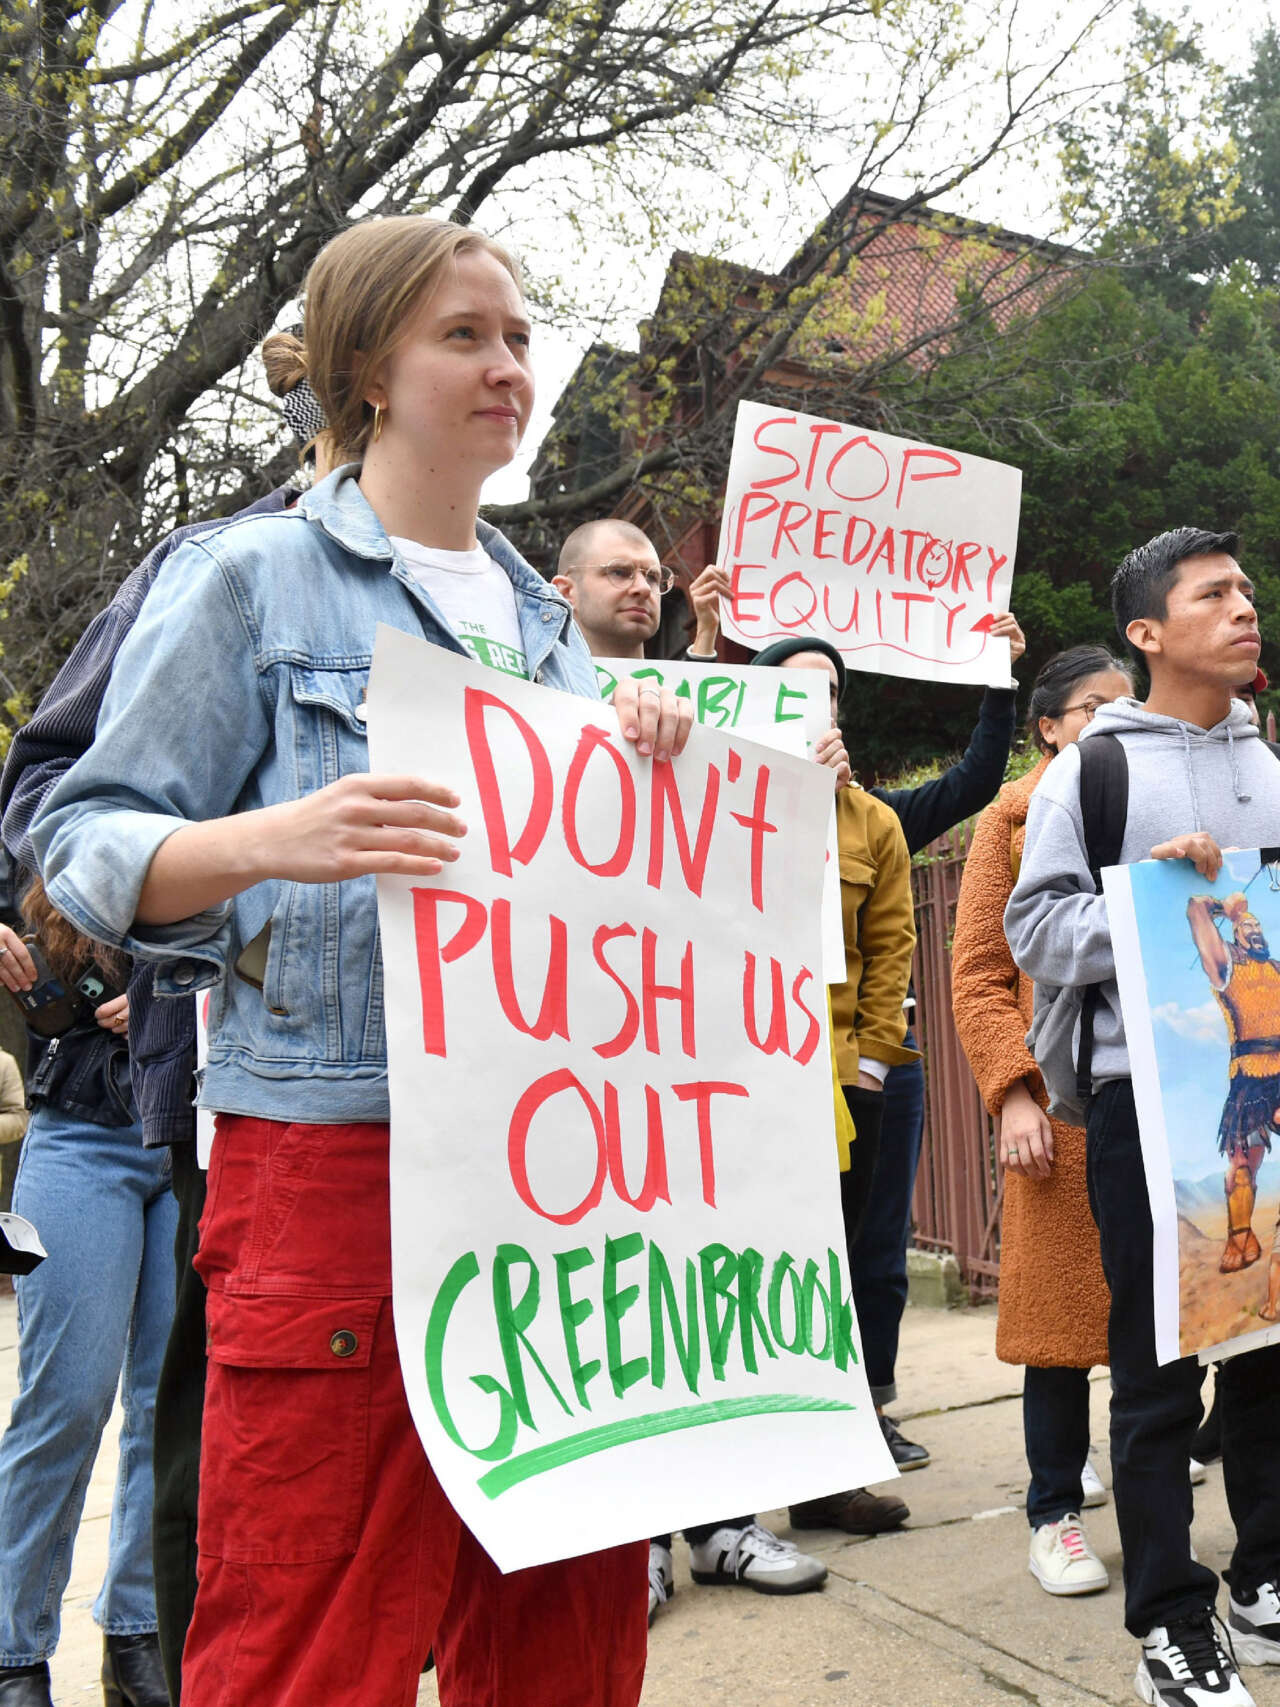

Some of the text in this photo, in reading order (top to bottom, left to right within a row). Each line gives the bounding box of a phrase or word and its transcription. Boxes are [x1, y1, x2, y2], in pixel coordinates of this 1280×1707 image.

[750, 416, 963, 510] STOP
[733, 491, 1008, 604] PREDATORY
[458, 620, 487, 634] THE
[730, 563, 967, 649] EQUITY
[408, 886, 698, 1060] PUSH
[507, 1066, 750, 1226] OUT
[424, 1231, 859, 1462] GREENBROOK
